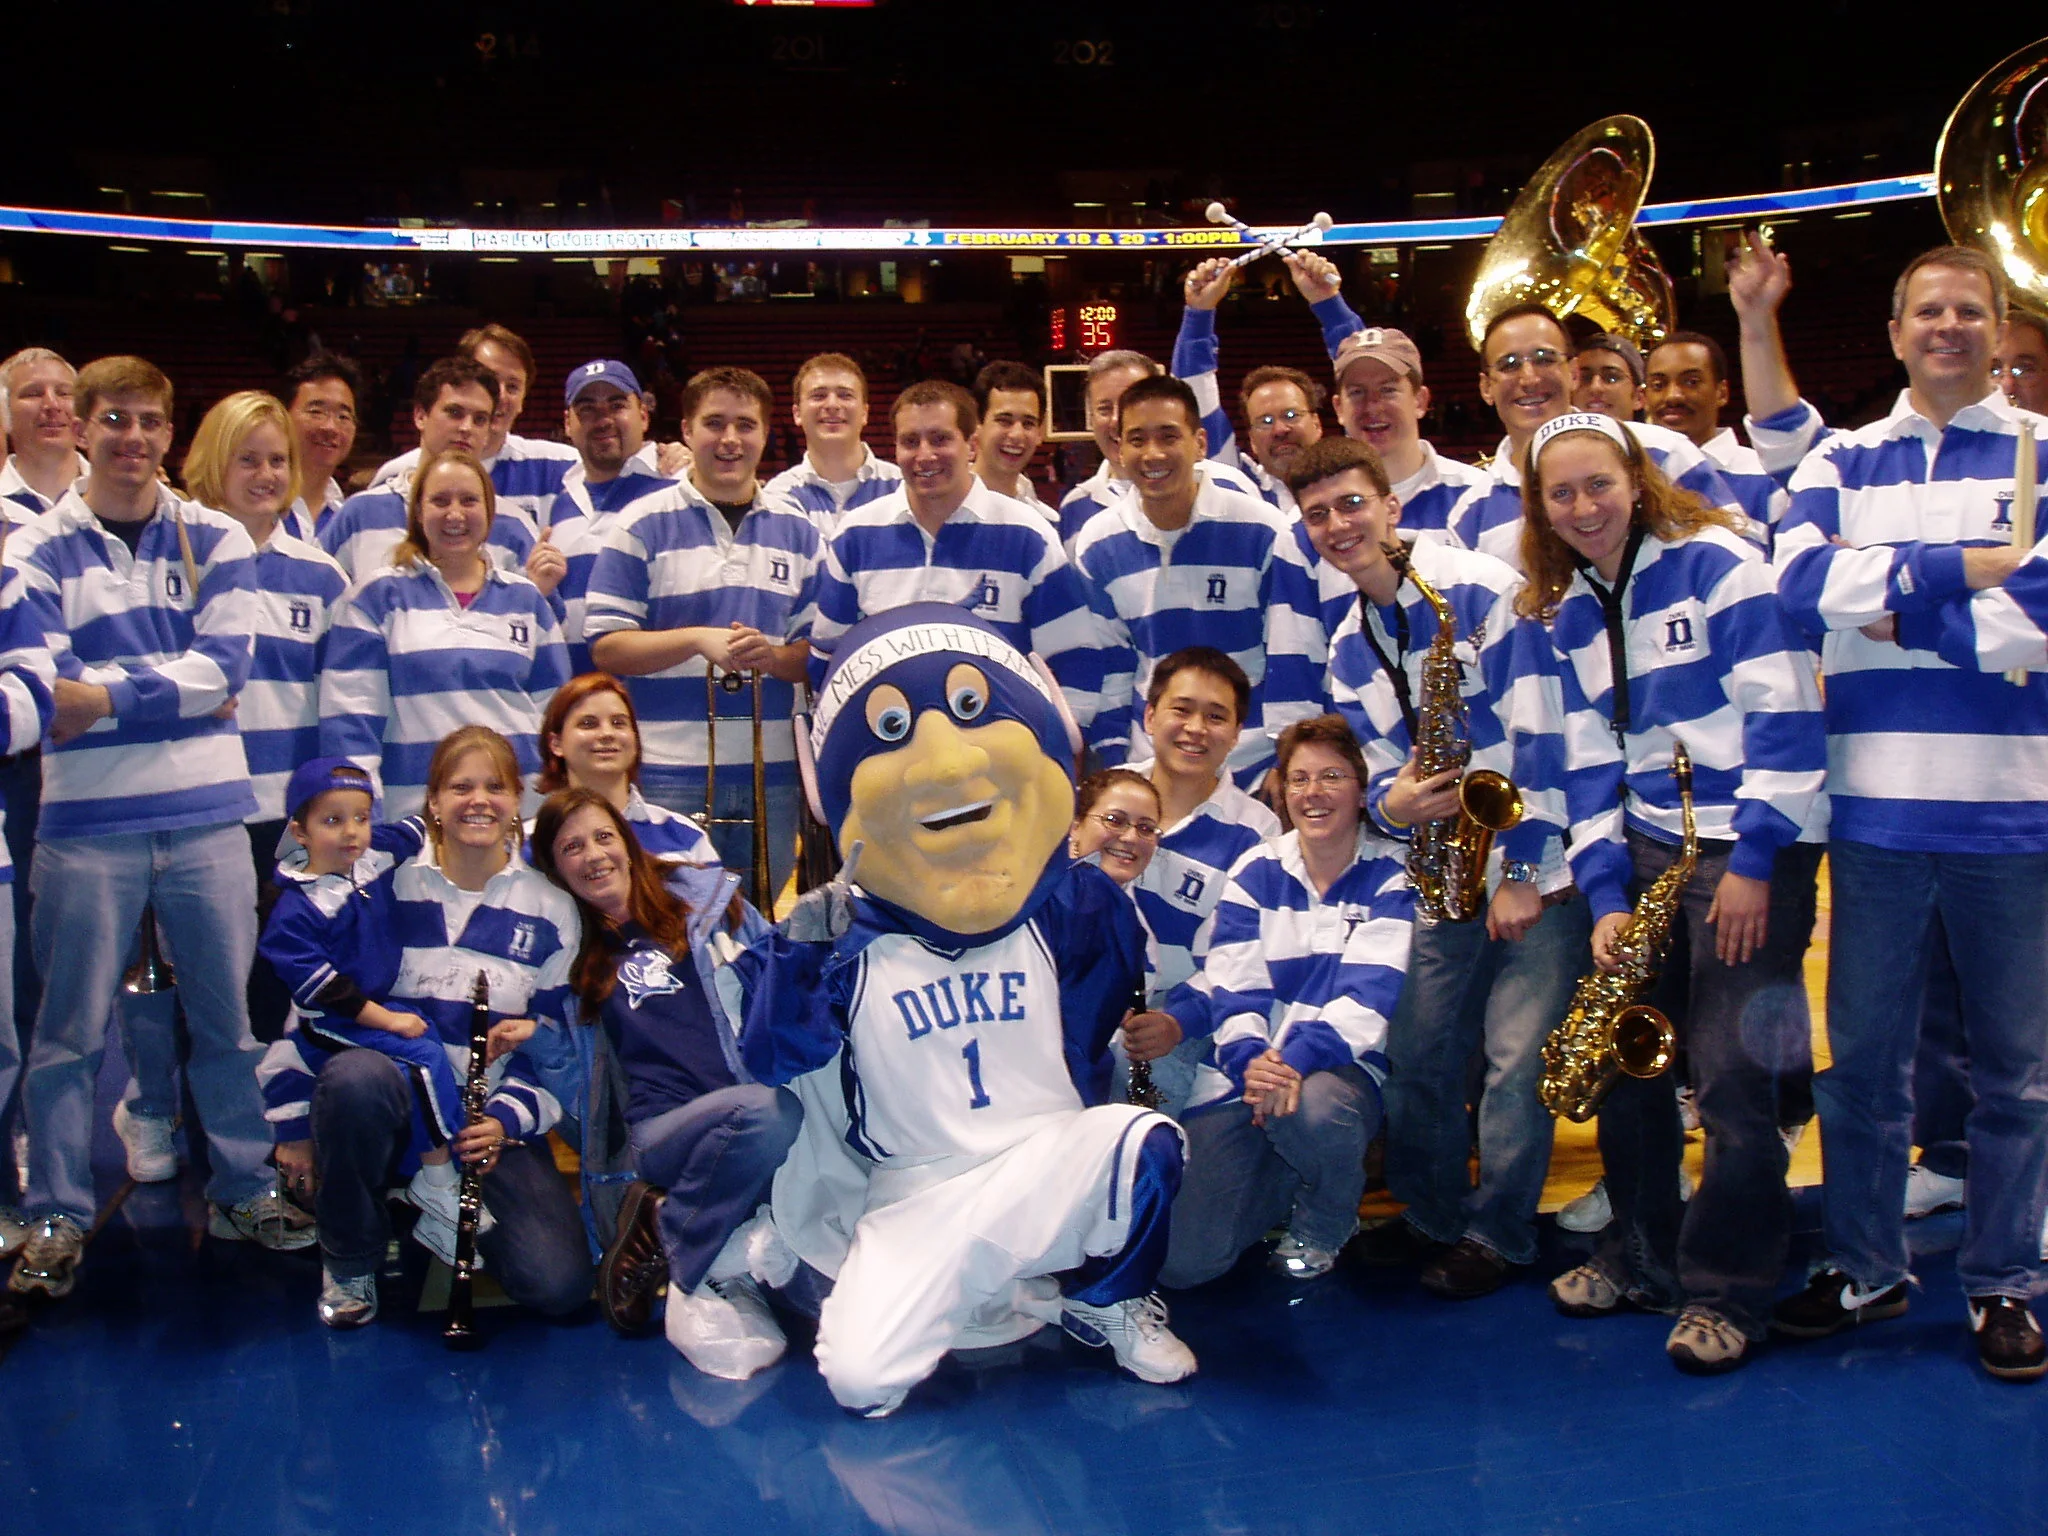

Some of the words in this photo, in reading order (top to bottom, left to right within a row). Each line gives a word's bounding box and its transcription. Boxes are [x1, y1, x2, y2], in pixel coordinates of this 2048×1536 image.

[1052, 39, 1116, 66] 202
[944, 232, 1060, 245] FEBRUARY
[1118, 232, 1146, 245] 20
[1164, 231, 1241, 244] 1:00PM
[1080, 306, 1117, 322] 12:00
[1082, 321, 1111, 346] 35
[1541, 415, 1601, 440] DUKE
[1665, 617, 1693, 647] D
[831, 647, 883, 704] MESS
[886, 627, 962, 656] WITH
[1175, 873, 1205, 901] D
[892, 971, 1026, 1041] DUKE
[962, 1038, 991, 1109] 1
